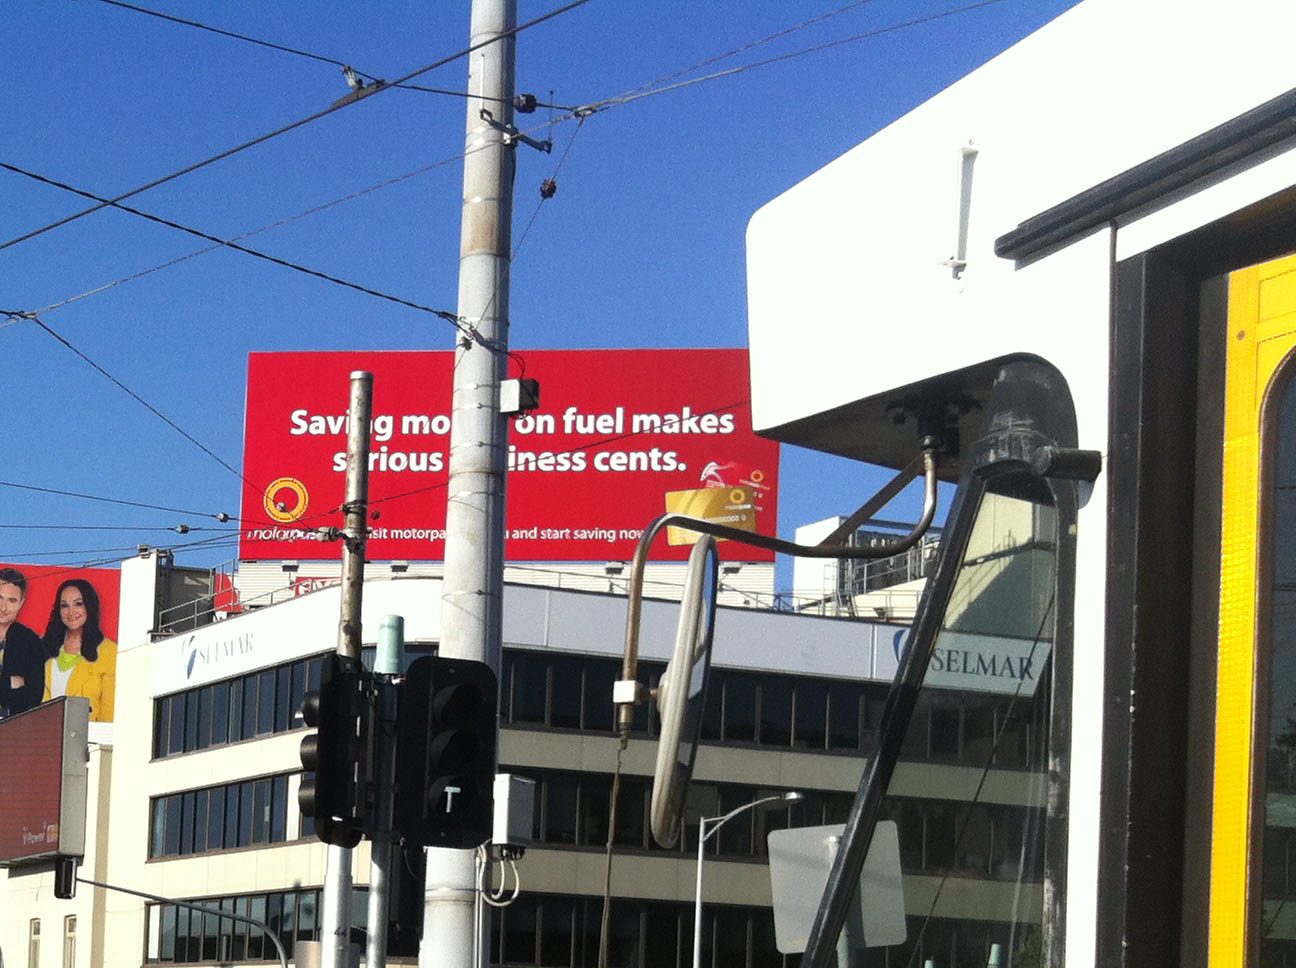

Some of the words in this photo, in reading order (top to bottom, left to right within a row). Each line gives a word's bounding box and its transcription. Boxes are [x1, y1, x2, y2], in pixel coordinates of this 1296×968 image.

[289, 408, 394, 442] Savig
[514, 413, 556, 435] on
[562, 406, 624, 435] fuel
[632, 406, 735, 435] makes
[332, 446, 444, 472] srious
[593, 447, 687, 473] cents.
[511, 526, 538, 540] and
[540, 527, 571, 540] start
[572, 526, 617, 543] saving
[929, 646, 1035, 681] SELMAR
